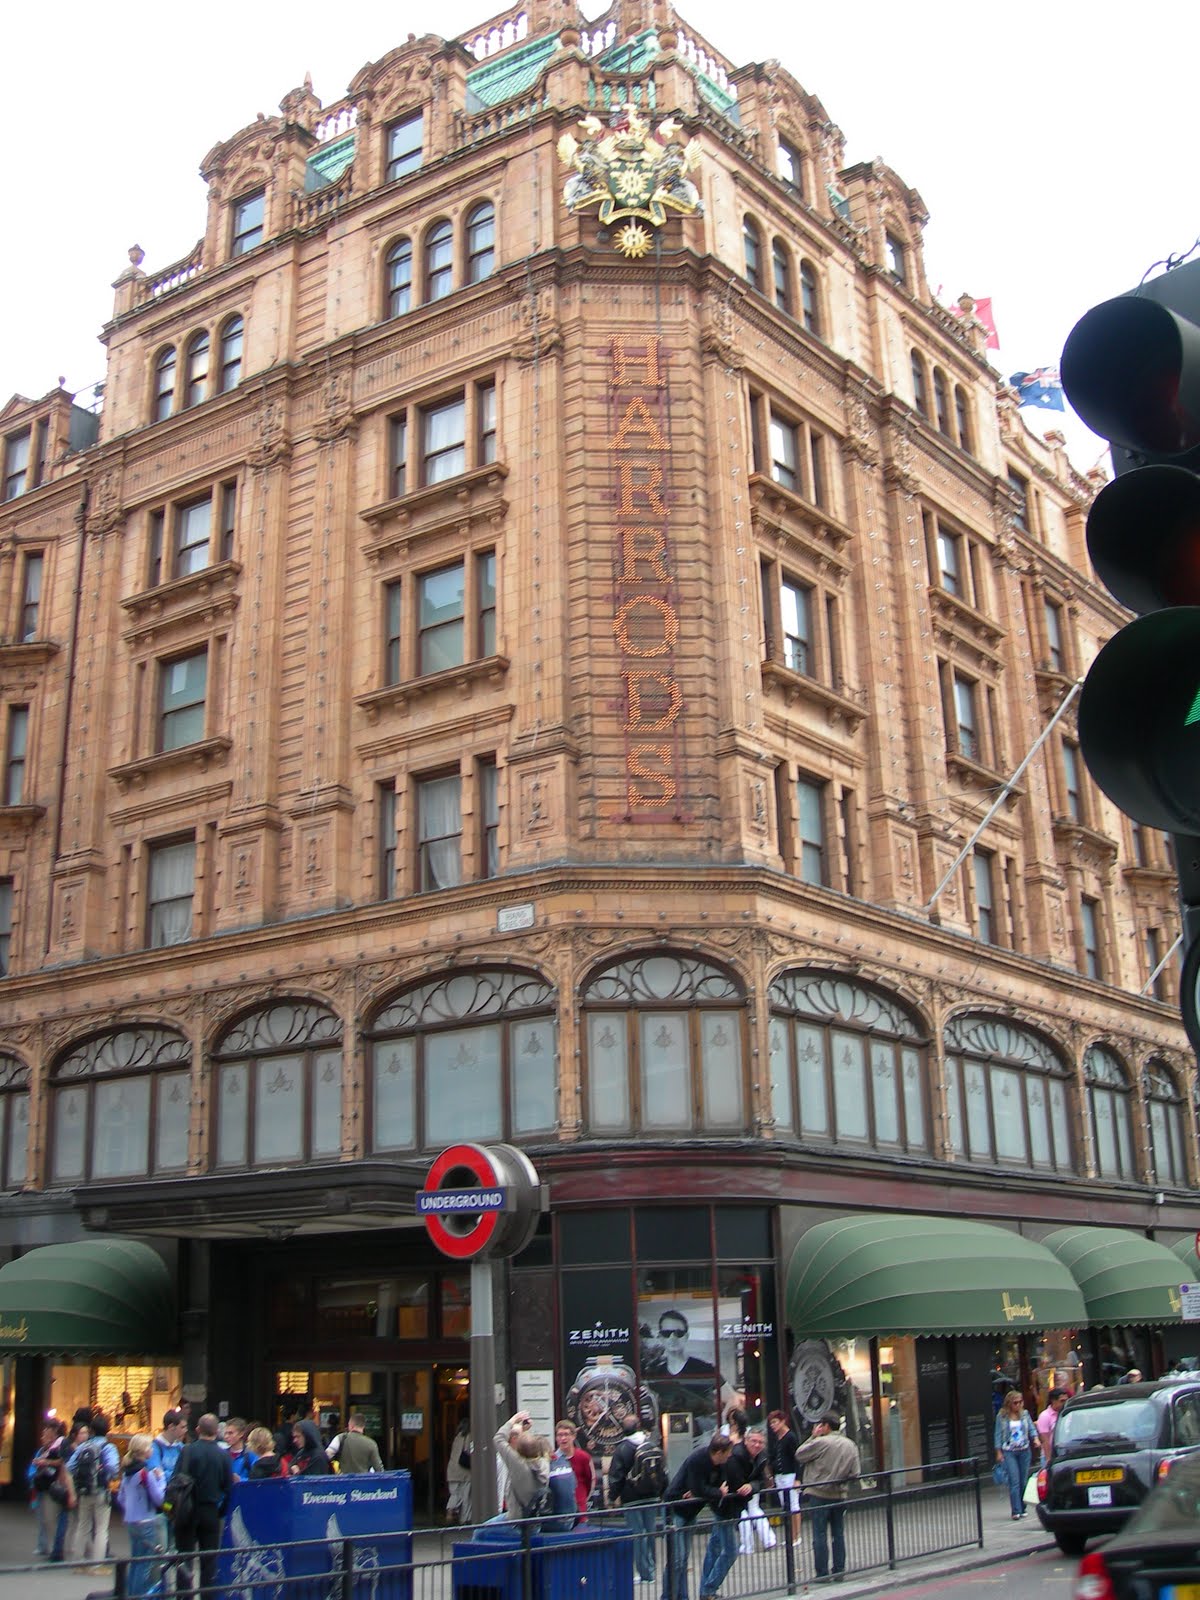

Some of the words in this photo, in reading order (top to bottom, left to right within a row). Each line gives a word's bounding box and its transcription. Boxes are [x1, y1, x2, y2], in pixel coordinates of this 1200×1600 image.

[606, 333, 683, 807] HARRODS
[420, 1193, 503, 1210] UNDERGROUND
[1001, 1291, 1035, 1321] Harrods
[569, 1327, 630, 1341] ZENITH
[722, 1322, 773, 1334] ZENITH
[303, 1491, 347, 1505] Evening
[350, 1487, 398, 1502] Standard
